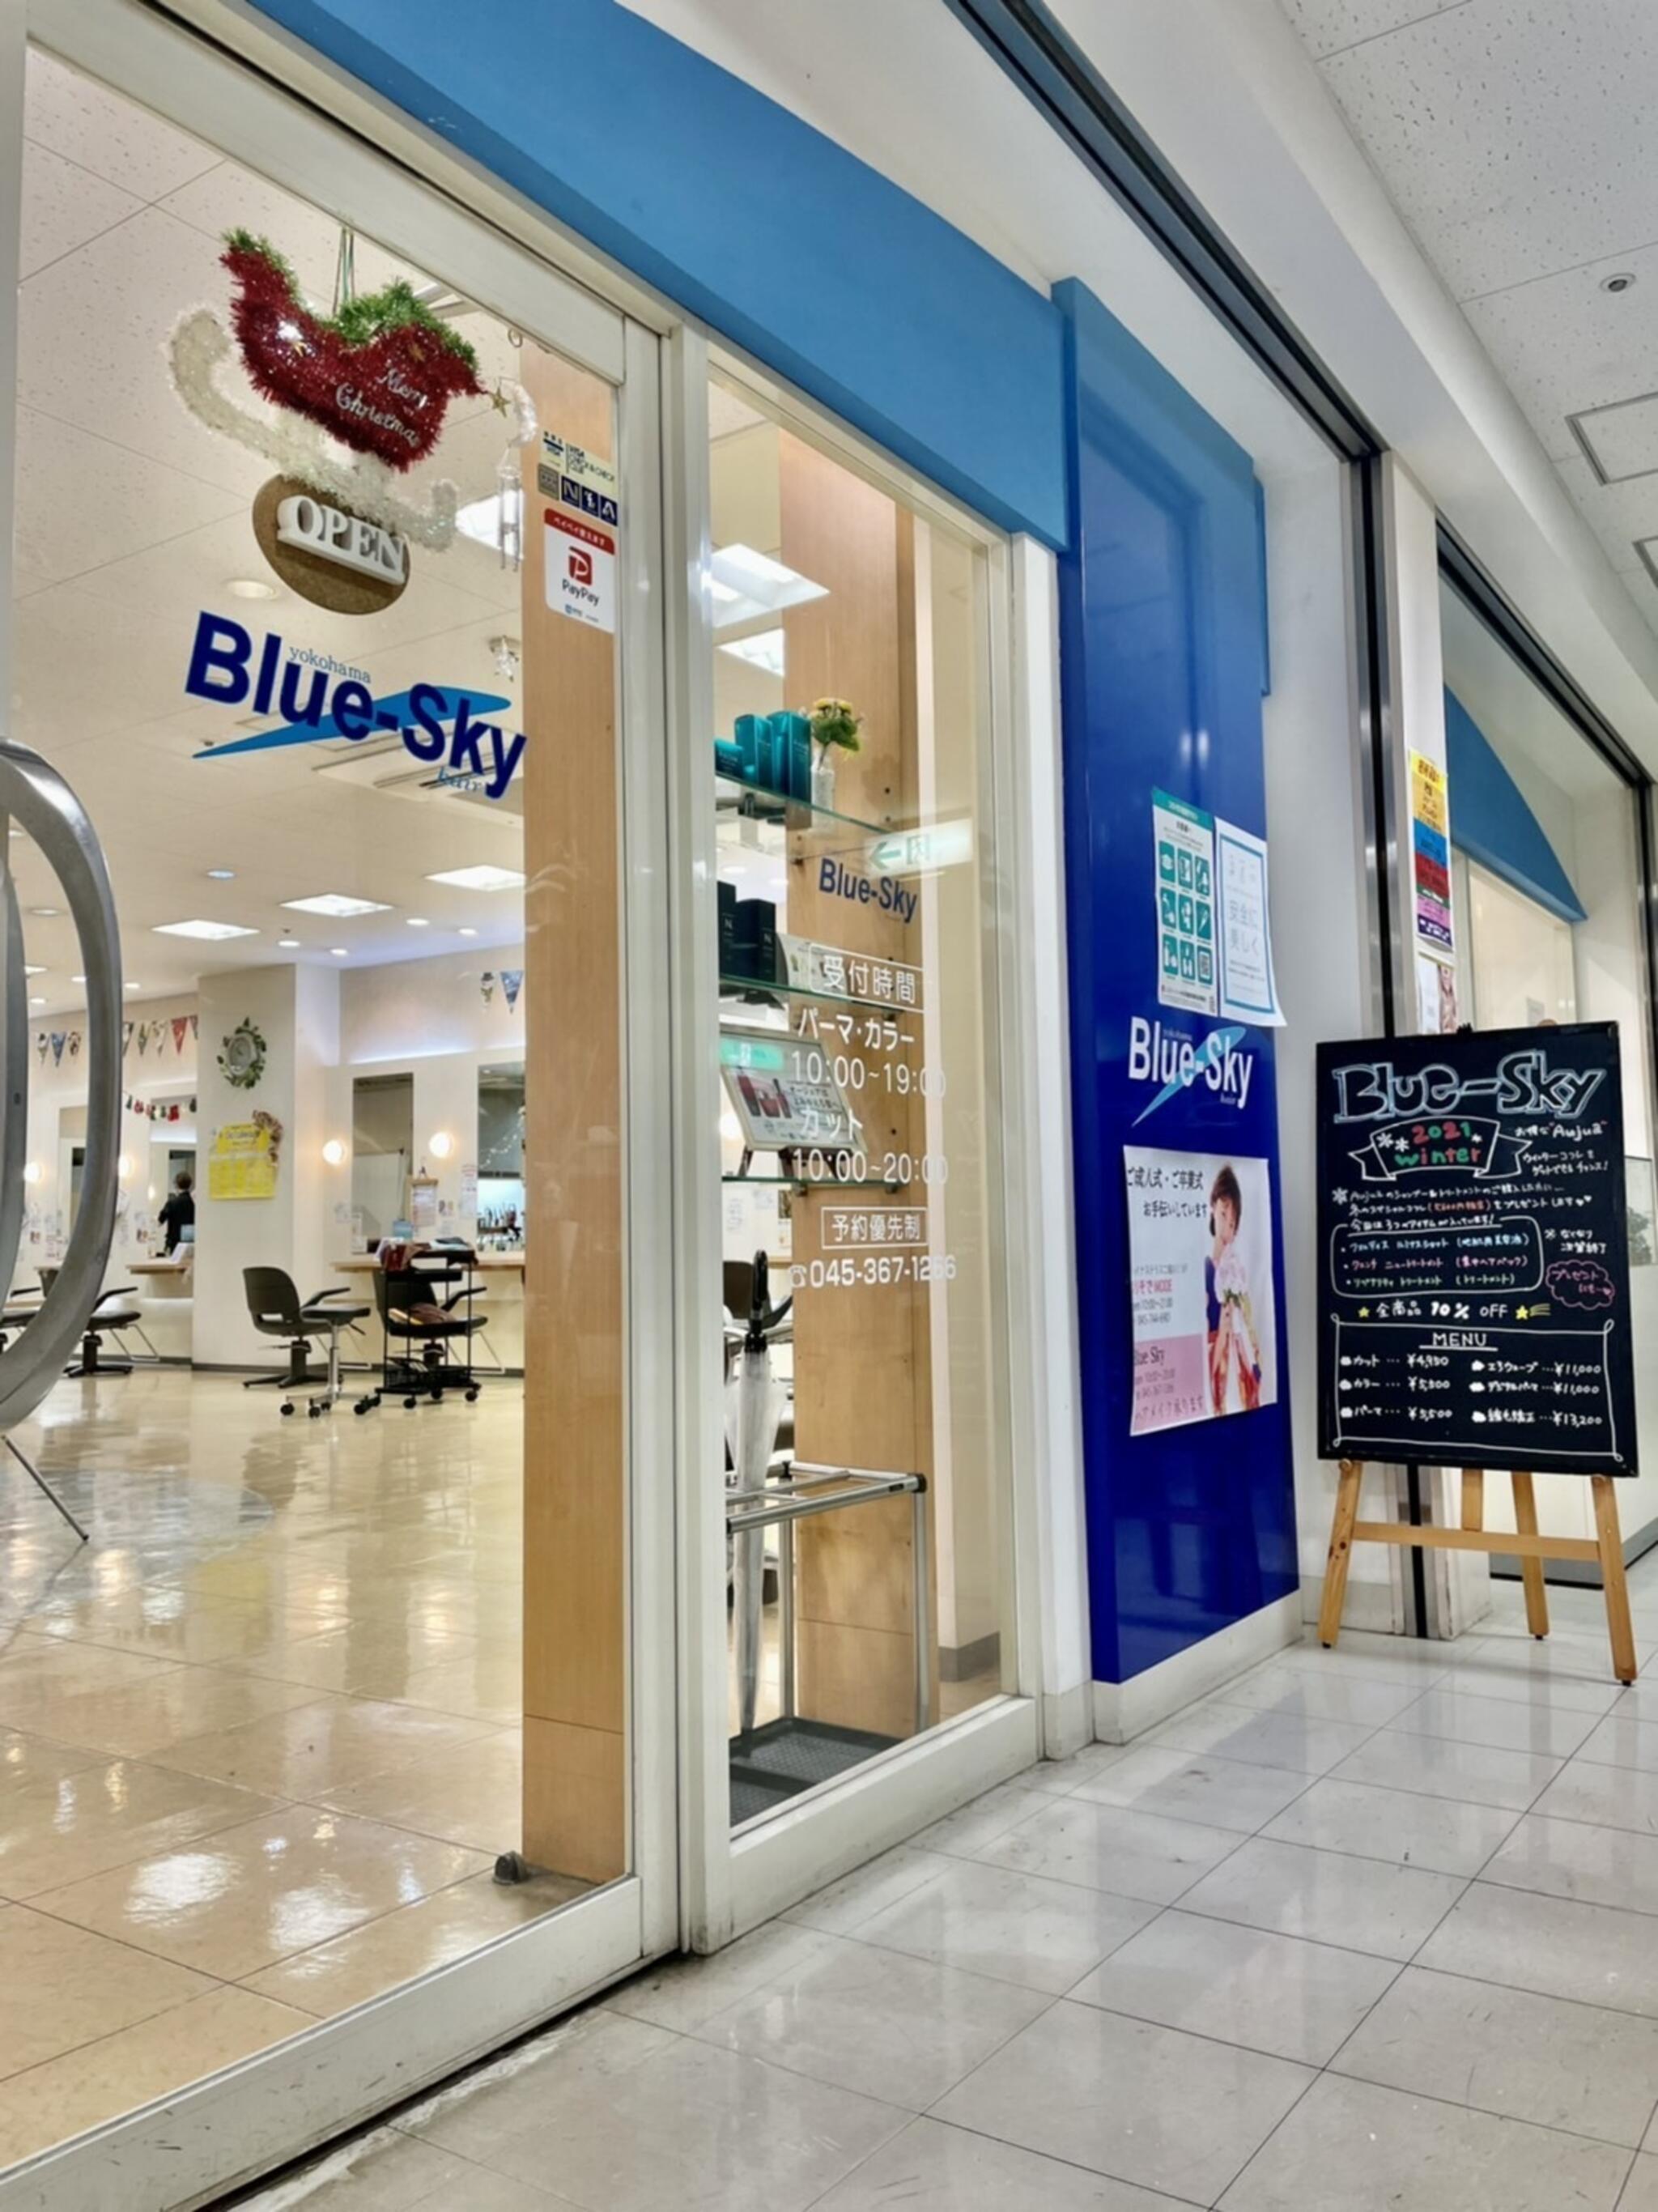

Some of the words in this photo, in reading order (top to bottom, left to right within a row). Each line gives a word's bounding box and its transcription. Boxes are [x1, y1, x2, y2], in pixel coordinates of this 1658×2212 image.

[335, 382, 422, 448] Christmas
[277, 495, 407, 578] OPEN
[562, 578, 600, 607] PayPay
[289, 645, 372, 684] yokohama
[185, 610, 527, 800] Blue-Sky
[818, 857, 918, 924] Blue-Sky
[823, 954, 916, 1005] 受付時間
[1128, 1015, 1253, 1110] Blue-Sky
[1332, 1049, 1607, 1123] Blue-Sky
[799, 1107, 863, 1140] カット
[1412, 1121, 1472, 1145] 2021
[1394, 1146, 1482, 1165] winter
[831, 1214, 920, 1243] 予約優先制
[1376, 1299, 1422, 1319] 全商品
[1431, 1332, 1487, 1347] MENU
[1354, 1378, 1380, 1390] カラー
[1354, 1404, 1383, 1417] パーマ
